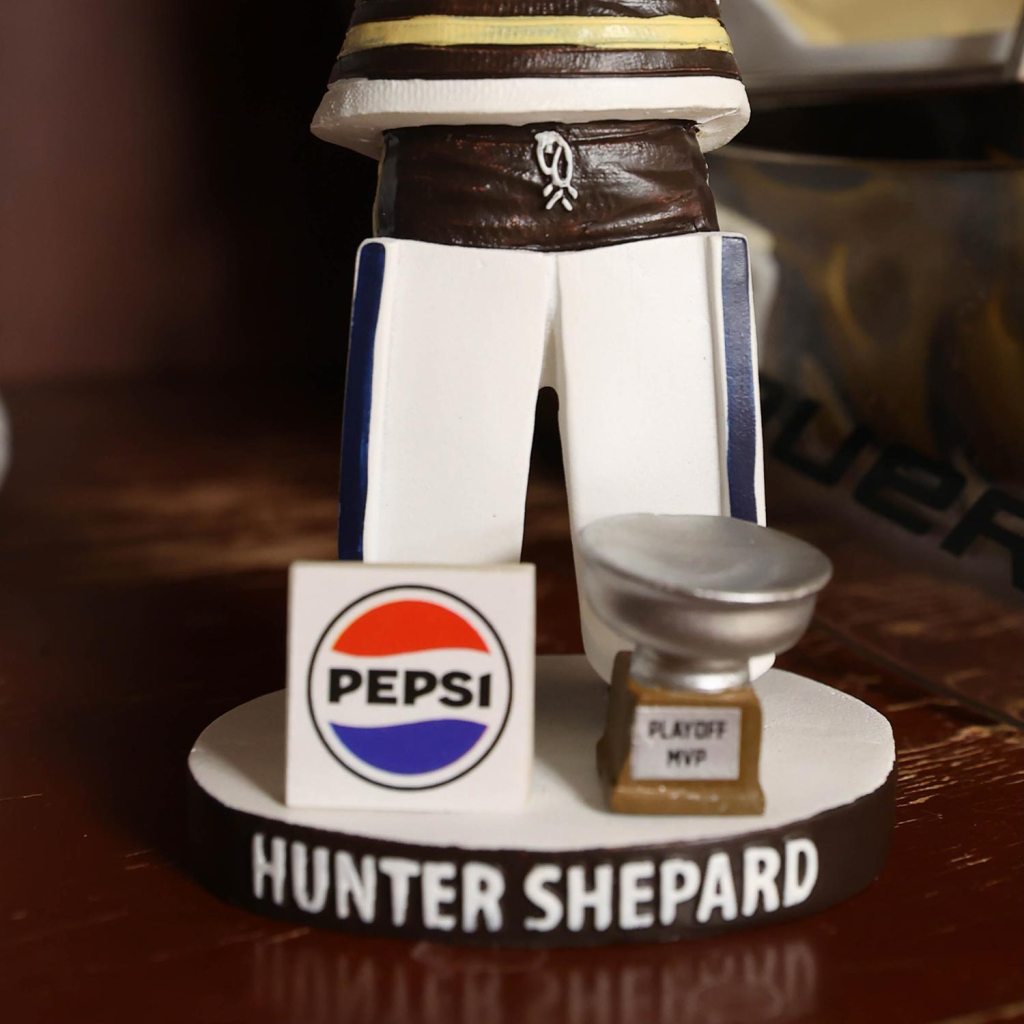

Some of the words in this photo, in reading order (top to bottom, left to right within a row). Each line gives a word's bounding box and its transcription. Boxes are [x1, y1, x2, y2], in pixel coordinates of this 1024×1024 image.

[328, 668, 492, 708] PEPSI
[648, 719, 727, 740] PLAYOFF
[666, 748, 708, 768] MVP
[251, 832, 506, 933] HUNTER
[523, 837, 819, 933] SHEPARD
